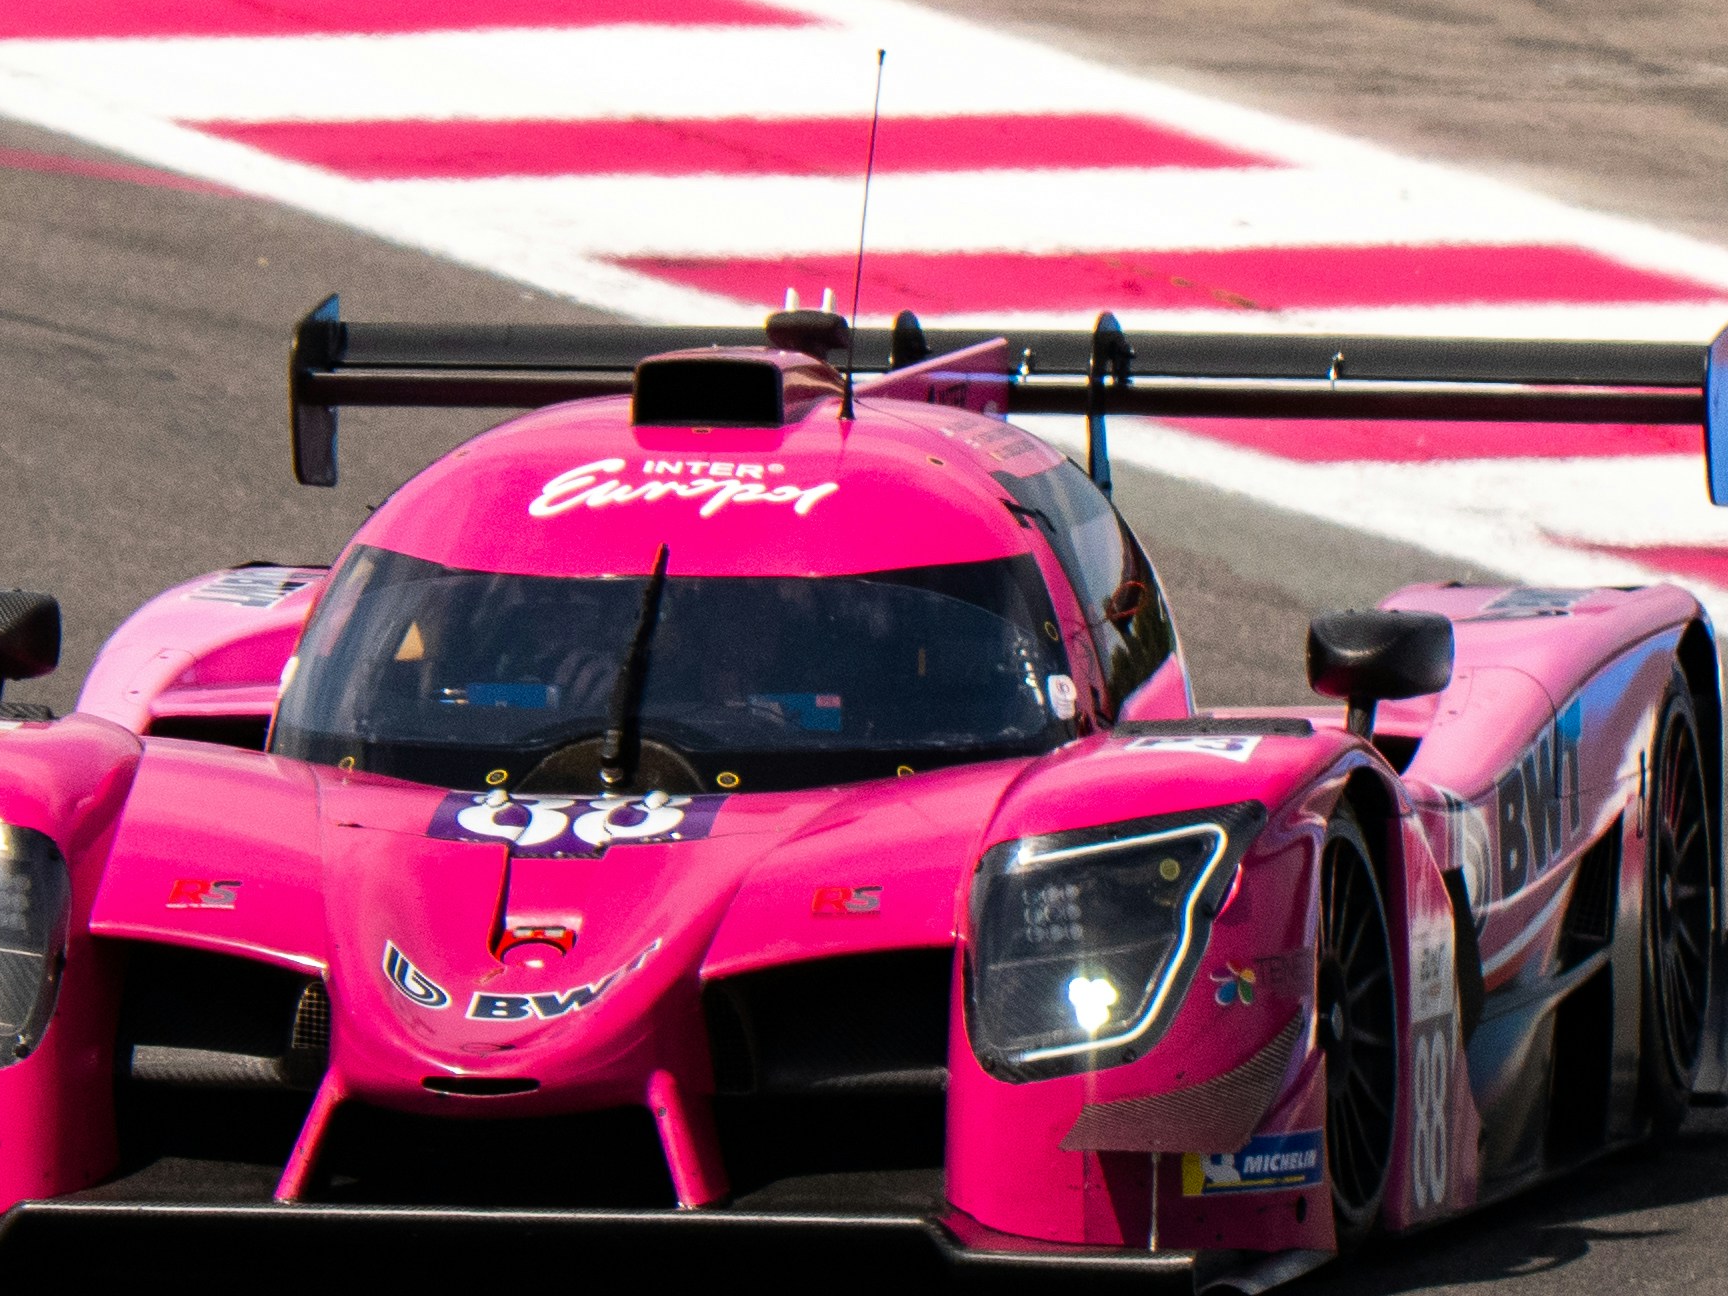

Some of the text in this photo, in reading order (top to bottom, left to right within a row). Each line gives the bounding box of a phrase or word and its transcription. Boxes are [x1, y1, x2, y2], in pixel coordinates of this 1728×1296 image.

[642, 459, 764, 479] INTER
[1495, 697, 1583, 903] BWT
[168, 879, 242, 907] RS
[812, 885, 883, 913] RS
[1412, 1028, 1449, 1210] 88
[1243, 1149, 1318, 1174] MICHELIN
